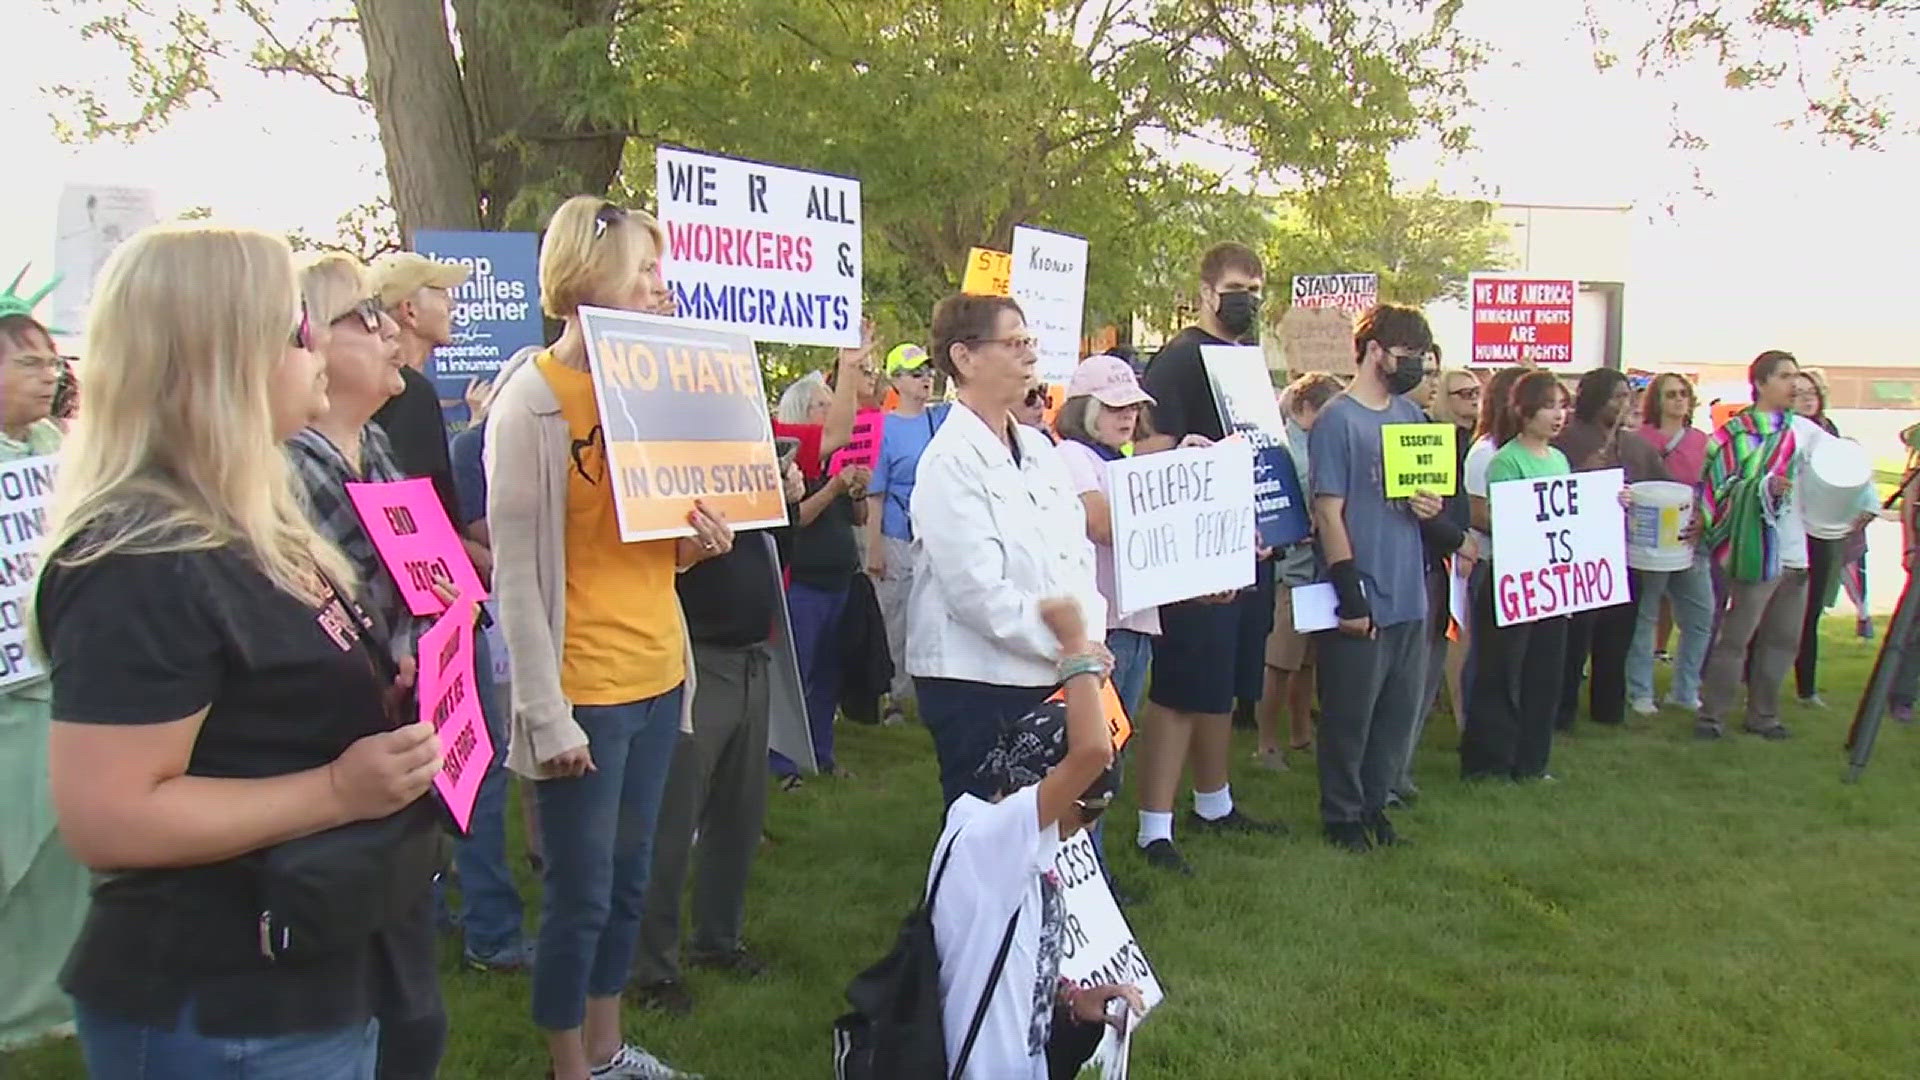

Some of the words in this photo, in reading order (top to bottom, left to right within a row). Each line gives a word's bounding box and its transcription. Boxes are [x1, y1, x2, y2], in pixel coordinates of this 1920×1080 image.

[667, 160, 717, 206] WE
[749, 174, 768, 213] R
[806, 185, 855, 224] ALL
[667, 220, 813, 273] WORKERS
[838, 242, 854, 278] &
[447, 275, 525, 299] milies
[1475, 284, 1493, 305] WE
[1495, 284, 1518, 305] ARE
[450, 299, 529, 327] gether
[667, 280, 849, 331] IMMIGRANTS
[1475, 309, 1532, 324] IMMIGRANT
[1534, 309, 1571, 324] RIGHTS
[1509, 326, 1537, 342] ARE
[598, 337, 660, 391] NO
[665, 347, 758, 398] HATE
[1475, 344, 1519, 360] HUMAN
[1400, 434, 1443, 447] ESSENTIAL
[1416, 453, 1433, 466] NOT
[0, 464, 59, 501] OIN
[622, 466, 650, 498] IN
[656, 464, 707, 497] OUR
[711, 463, 777, 494] STATE
[1128, 460, 1215, 516] RELEASE
[1398, 472, 1449, 486] DEPORTABLE
[1533, 479, 1579, 522] ICE
[383, 506, 418, 536] END
[1195, 507, 1249, 559] PEOPLE
[1545, 529, 1573, 565] IS
[1500, 558, 1613, 622] GESTAPO
